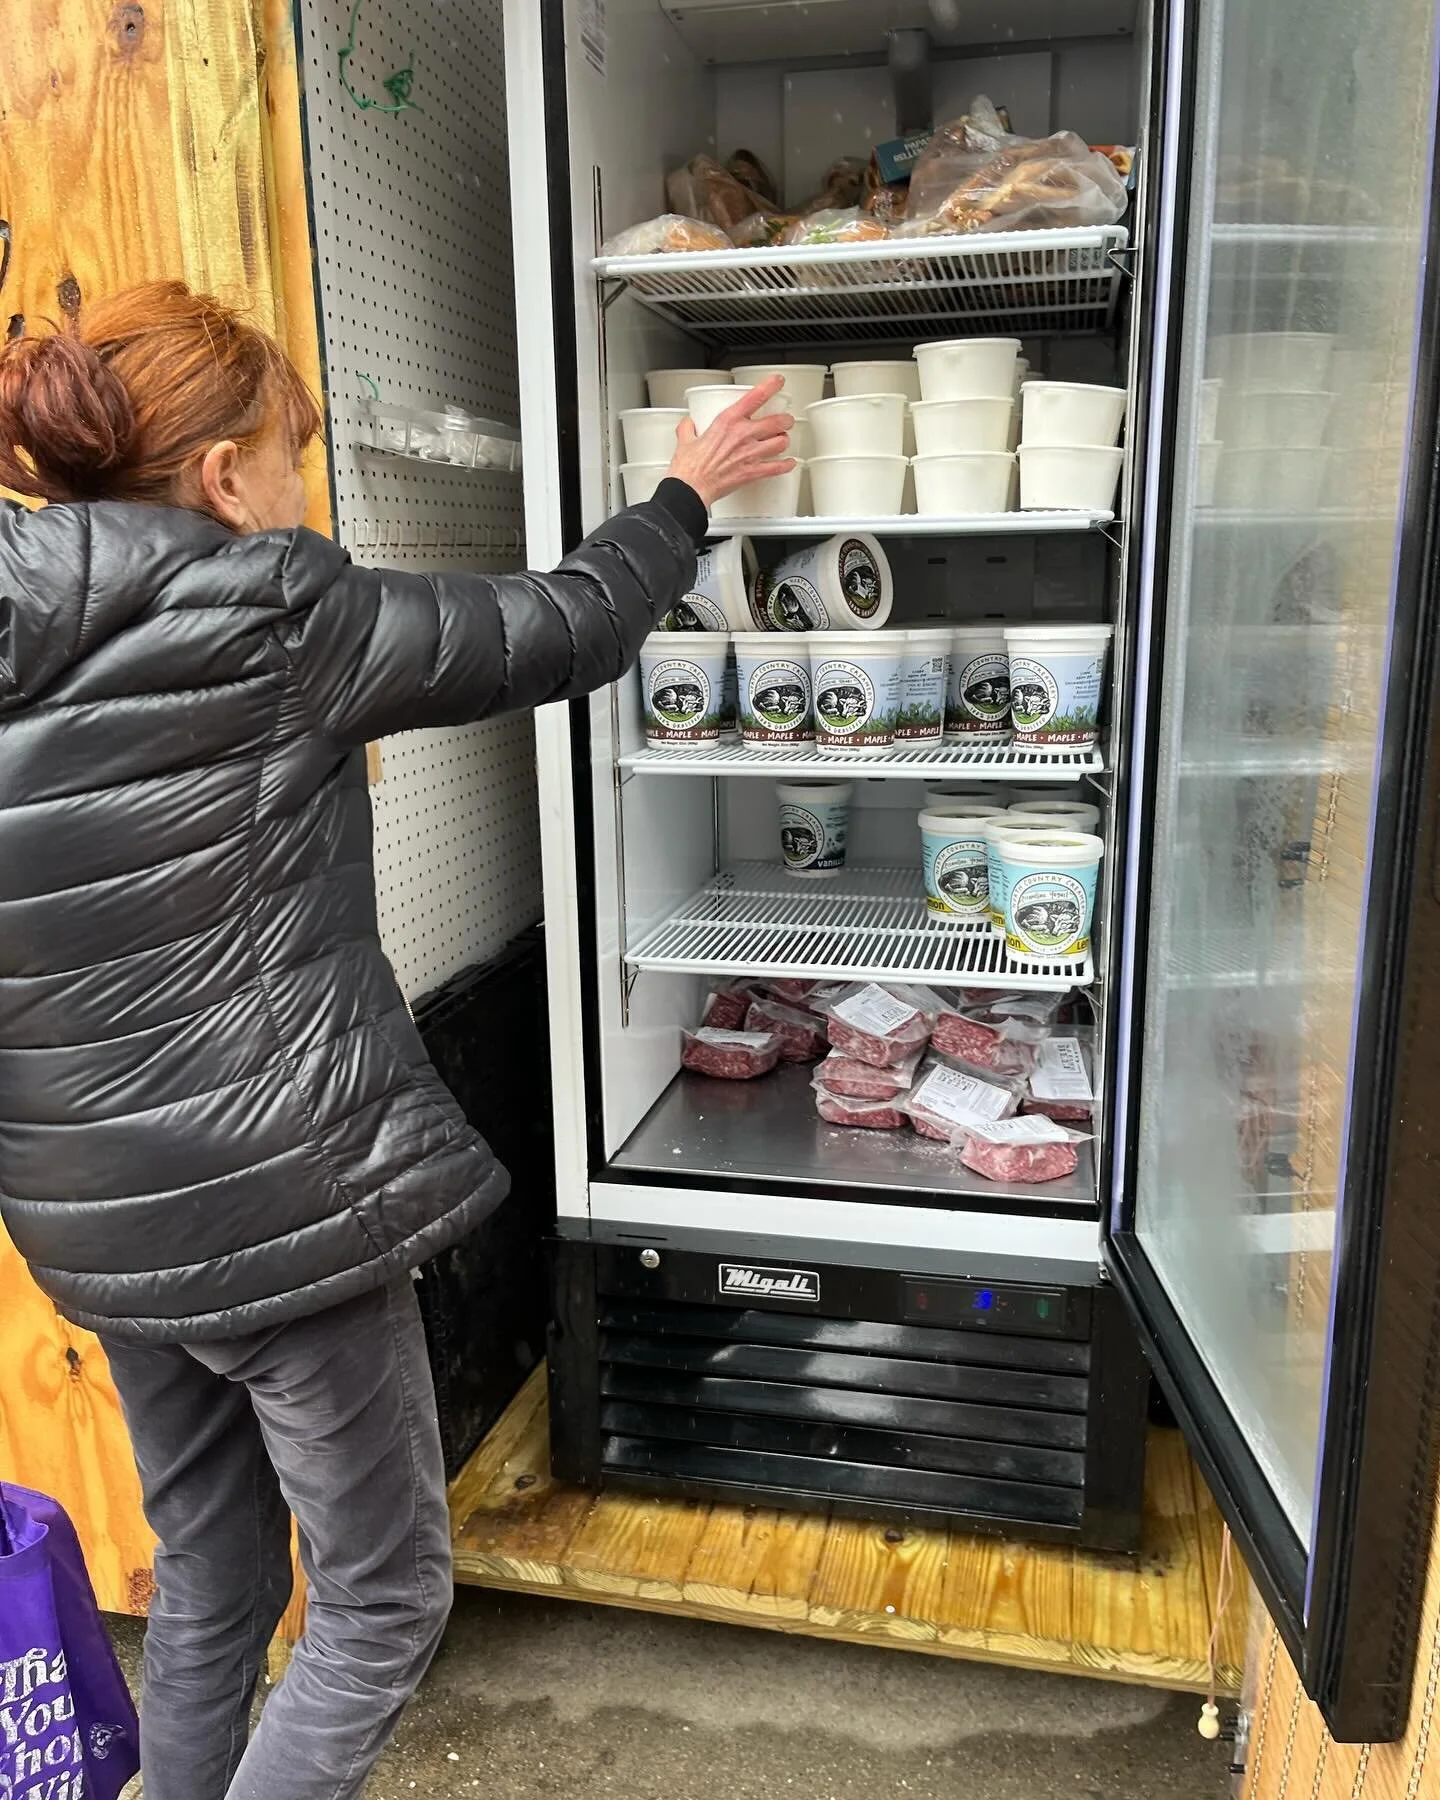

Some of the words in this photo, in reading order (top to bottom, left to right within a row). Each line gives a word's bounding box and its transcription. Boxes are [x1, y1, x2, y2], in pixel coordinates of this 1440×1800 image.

[759, 663, 790, 673] COUNTRY
[850, 667, 873, 702] CREAMERY
[1033, 665, 1056, 700] CREAMERY
[980, 721, 1002, 729] MAPLE
[767, 732, 794, 740] MAPLE
[828, 735, 854, 744] MAPLE
[864, 735, 888, 744] MAPLE
[1016, 732, 1038, 741] MAPLE
[1047, 733, 1077, 742] MAPLE
[946, 843, 981, 854] COUNTRY
[1023, 875, 1063, 886] COUNTRY
[1065, 880, 1086, 915] CREAMERY
[726, 1268, 813, 1293] Migali
[0, 1692, 75, 1745] You
